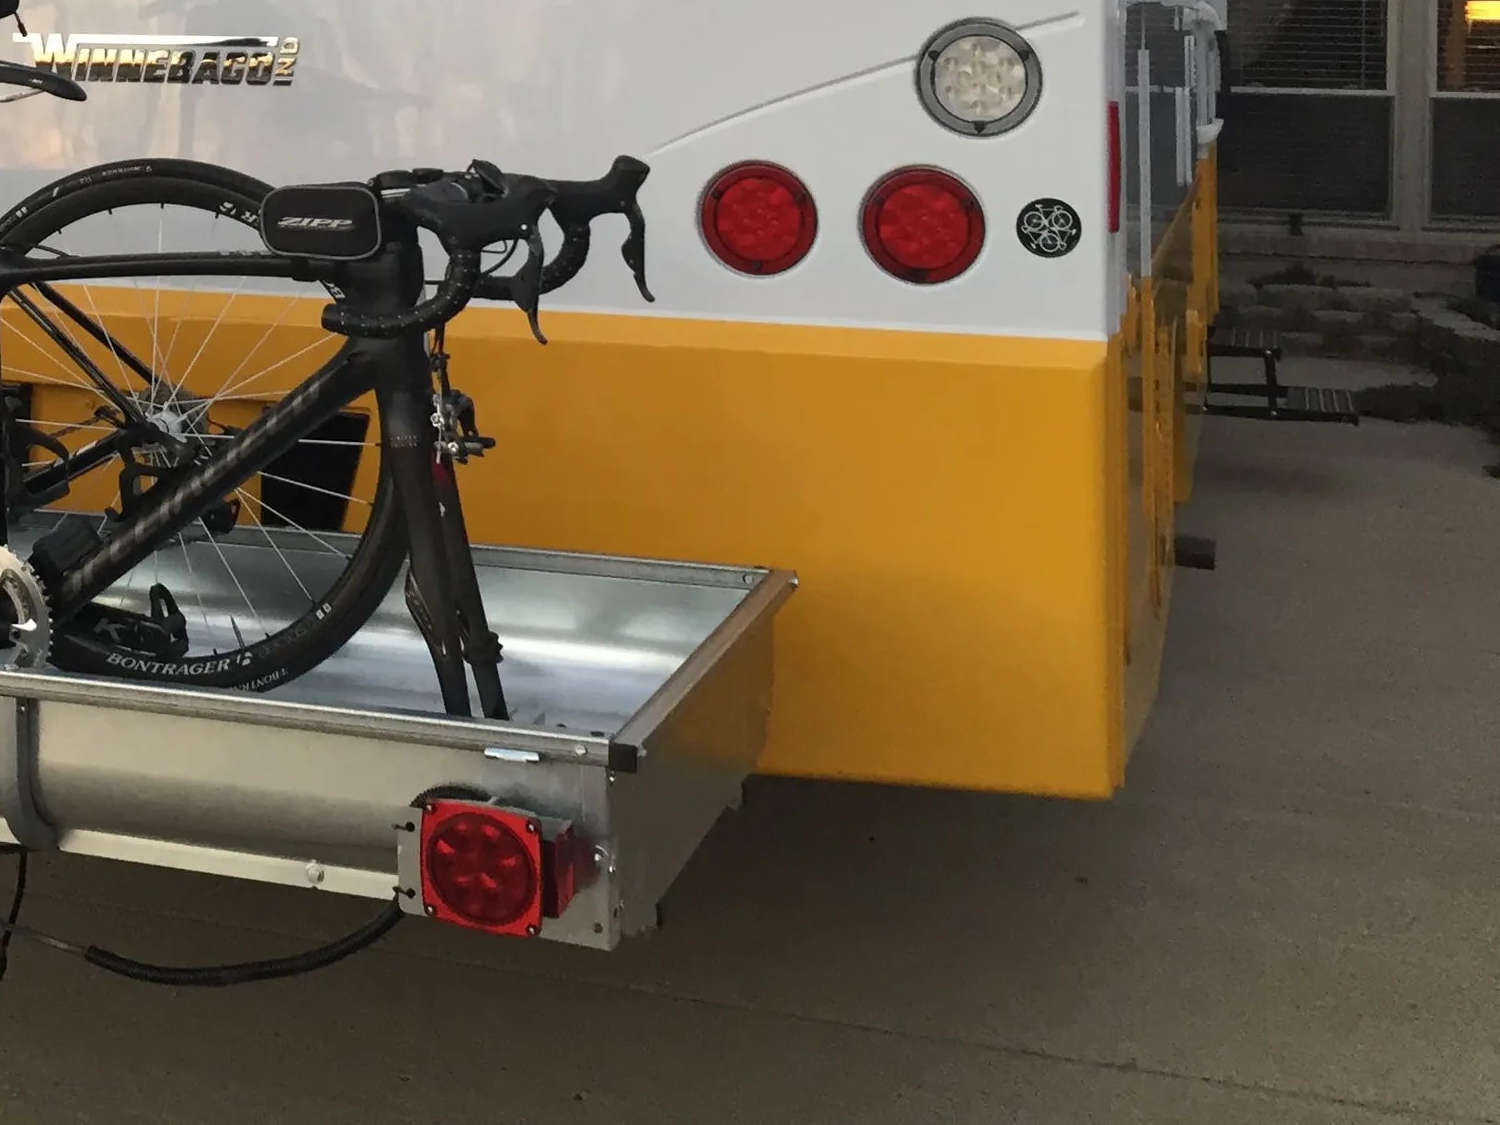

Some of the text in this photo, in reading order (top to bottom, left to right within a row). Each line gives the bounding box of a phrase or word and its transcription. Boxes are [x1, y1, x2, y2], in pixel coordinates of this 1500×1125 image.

[13, 33, 278, 86] WINNEBAGO
[277, 216, 353, 228] ZIPP
[106, 651, 231, 676] BONTRAGER
